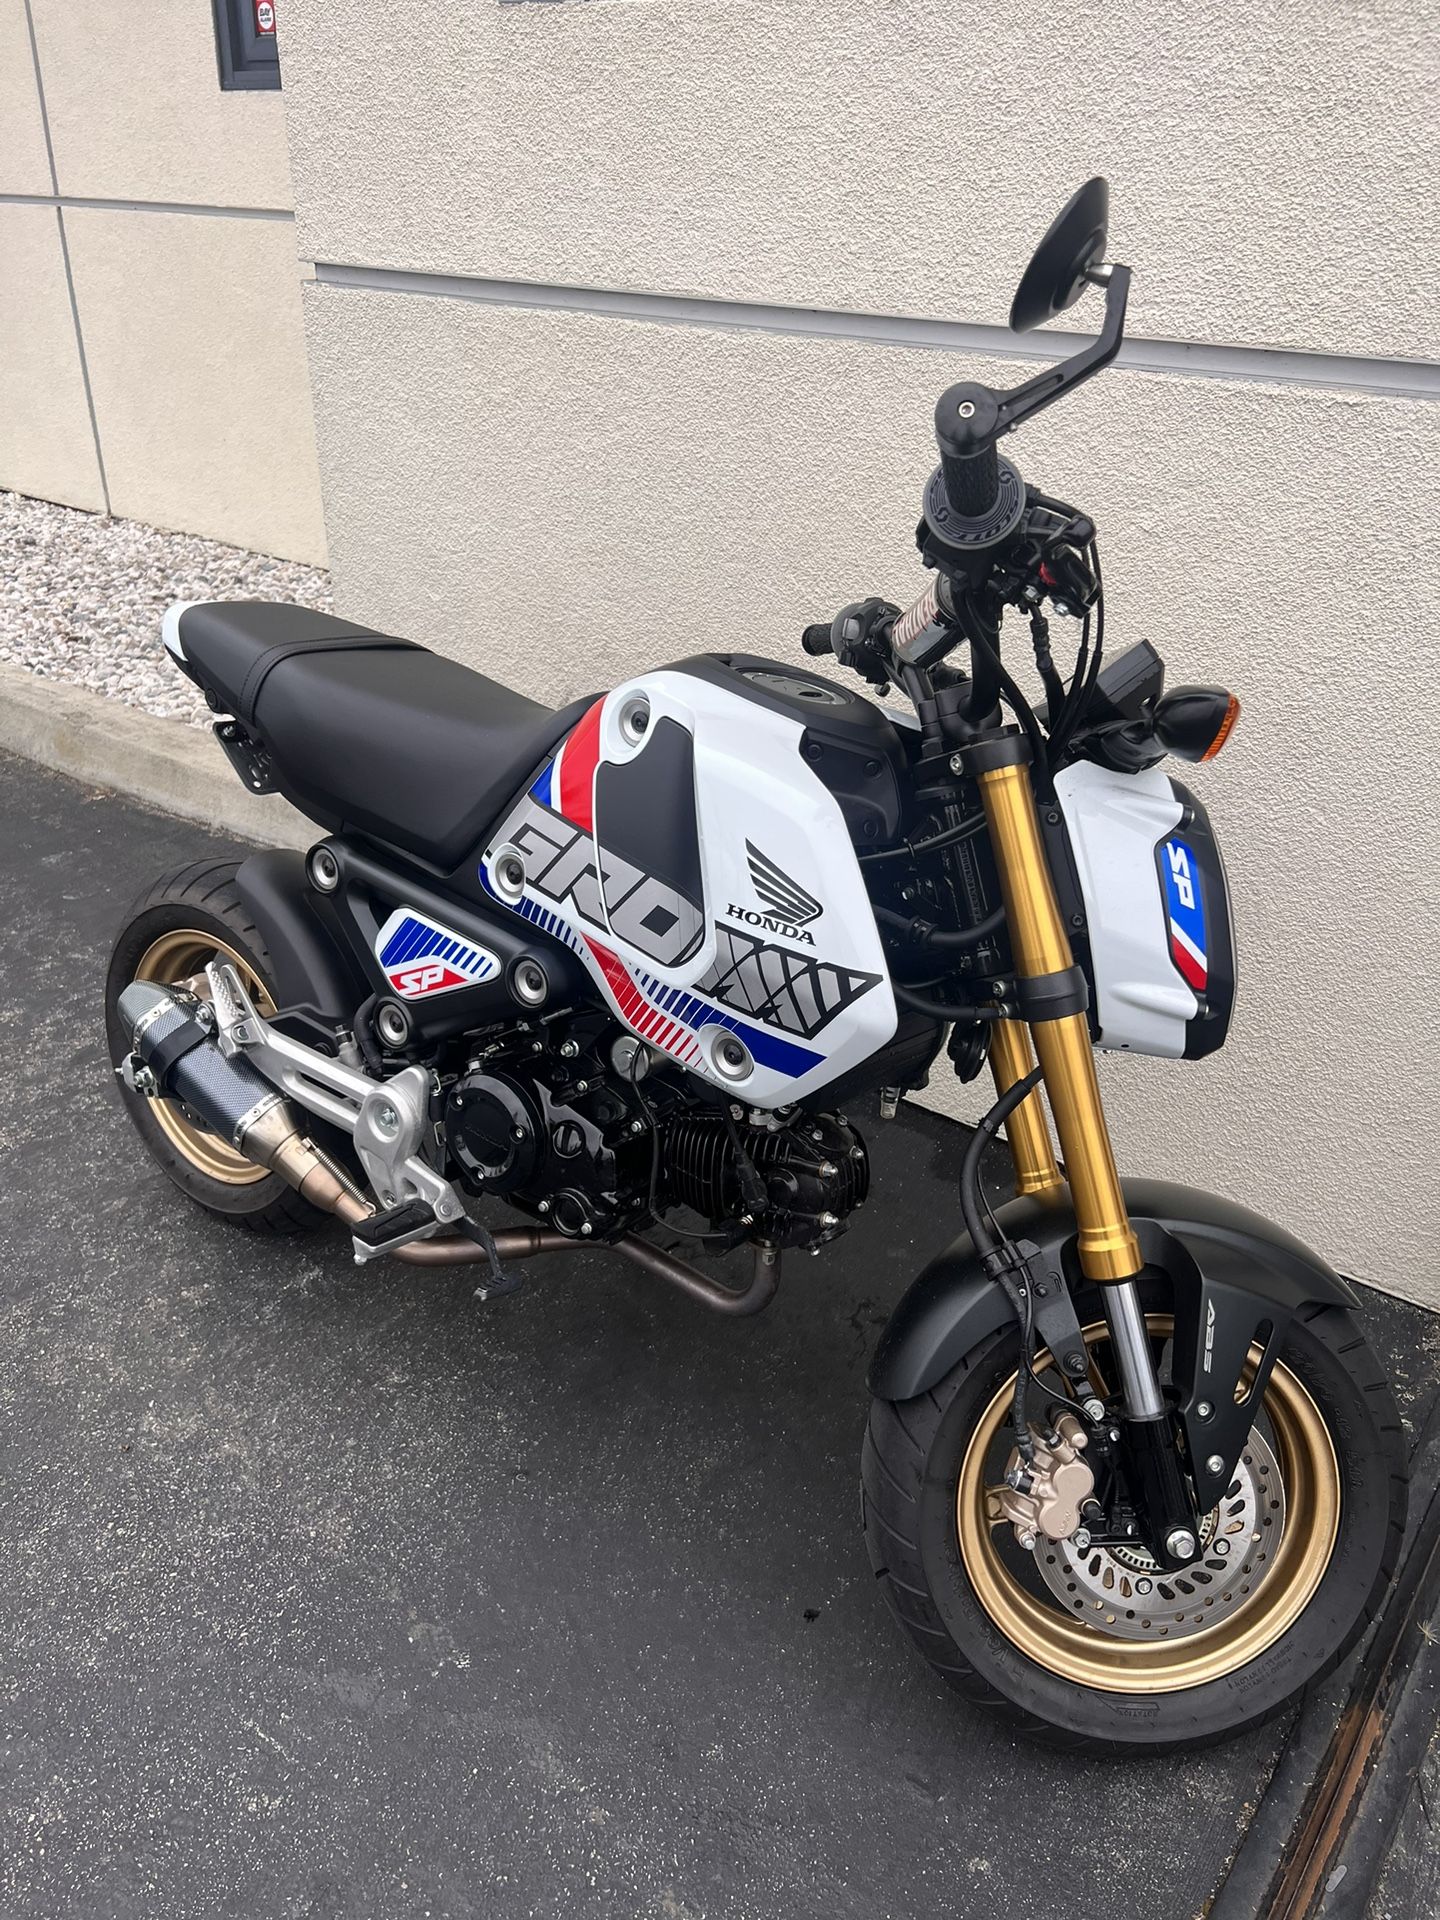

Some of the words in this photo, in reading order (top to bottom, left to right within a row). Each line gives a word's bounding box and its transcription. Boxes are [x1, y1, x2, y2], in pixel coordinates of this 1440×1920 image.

[1166, 842, 1195, 910] SP
[726, 903, 817, 946] HONDA
[400, 966, 445, 992] SP
[1204, 1298, 1216, 1373] ABS
